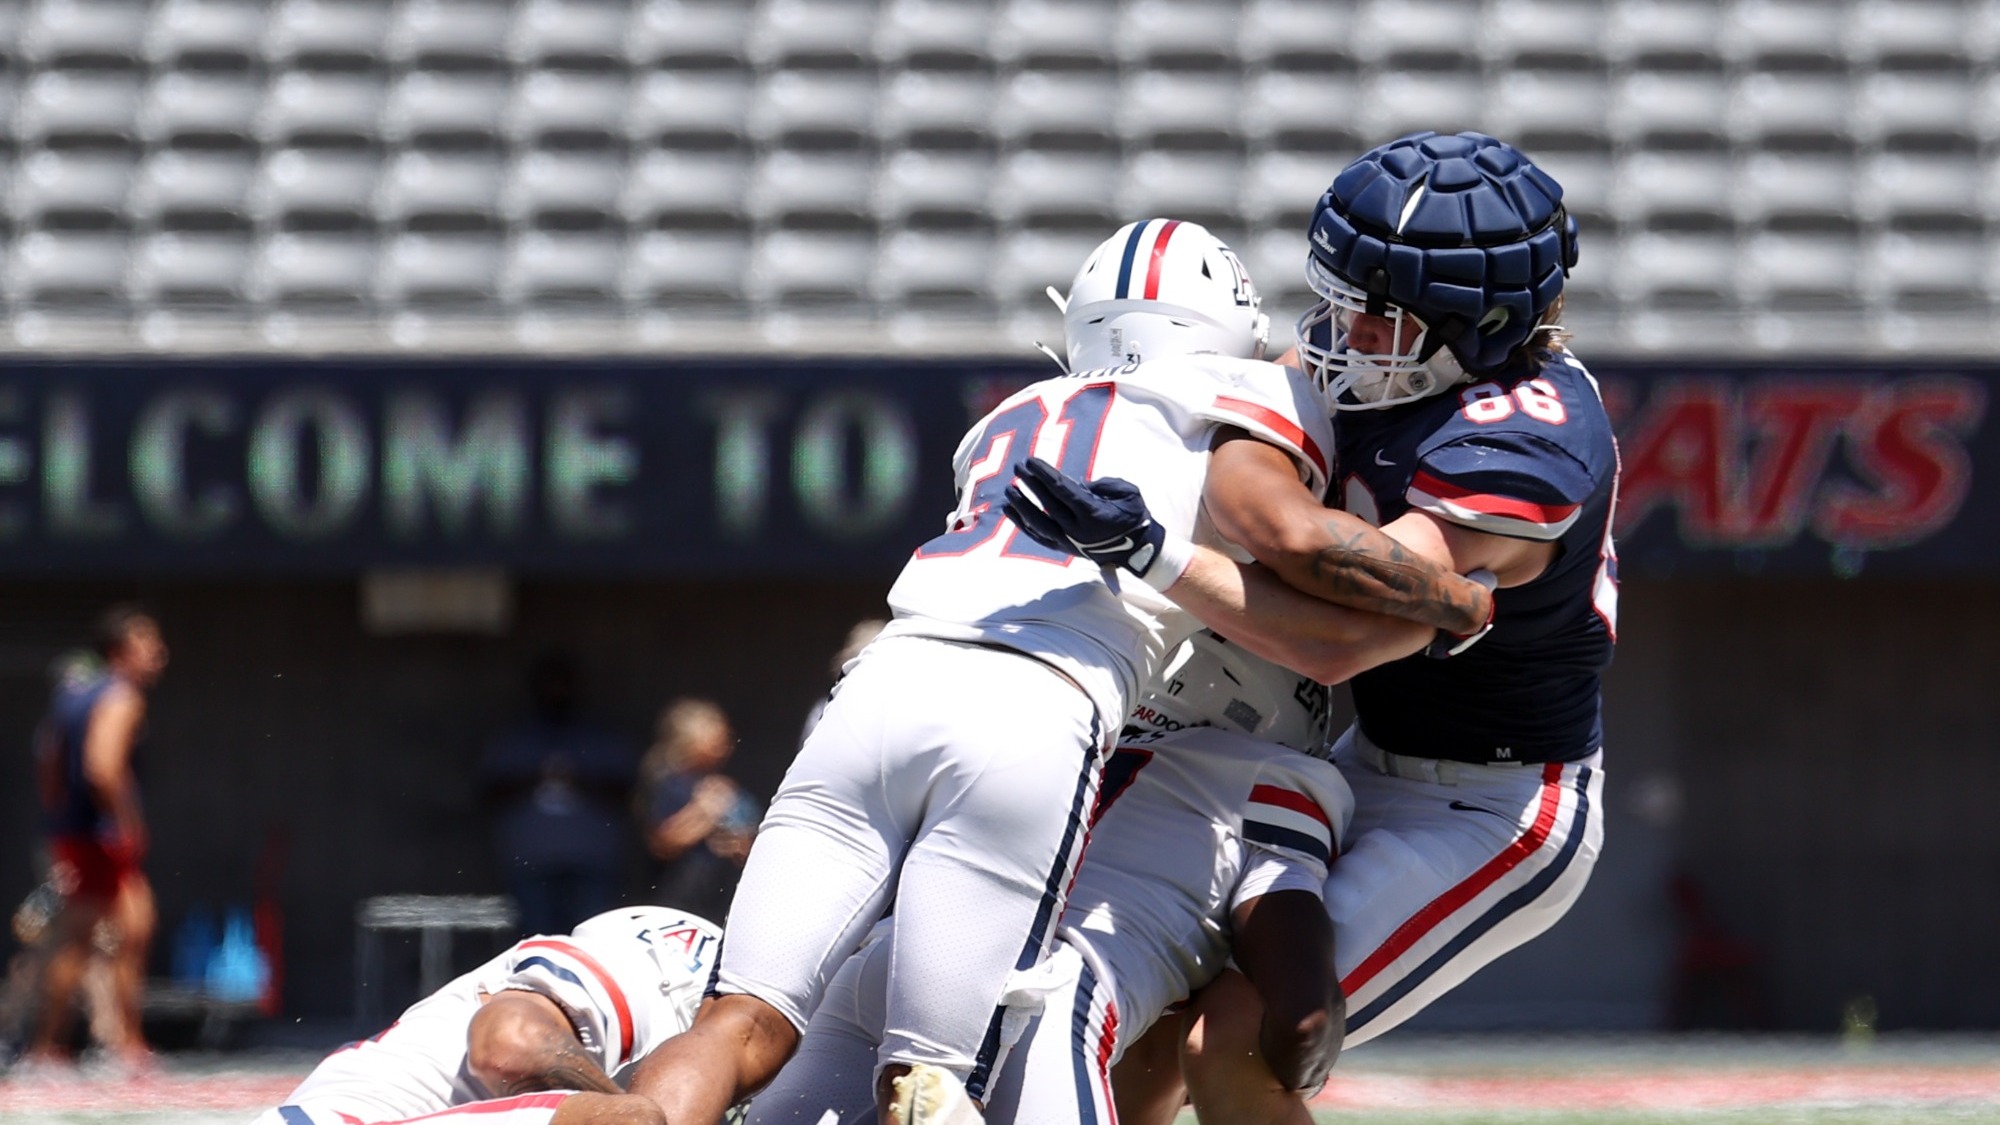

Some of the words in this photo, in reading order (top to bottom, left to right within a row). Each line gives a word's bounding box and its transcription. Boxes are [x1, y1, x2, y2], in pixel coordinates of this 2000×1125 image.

[1126, 353, 1141, 365] 31
[1459, 377, 1568, 425] 86
[699, 390, 917, 545] TO
[914, 381, 1115, 568] 31
[1612, 373, 1975, 546] ATS
[1167, 679, 1184, 696] 17
[1131, 704, 1186, 732] ARDO
[1496, 747, 1511, 759] M
